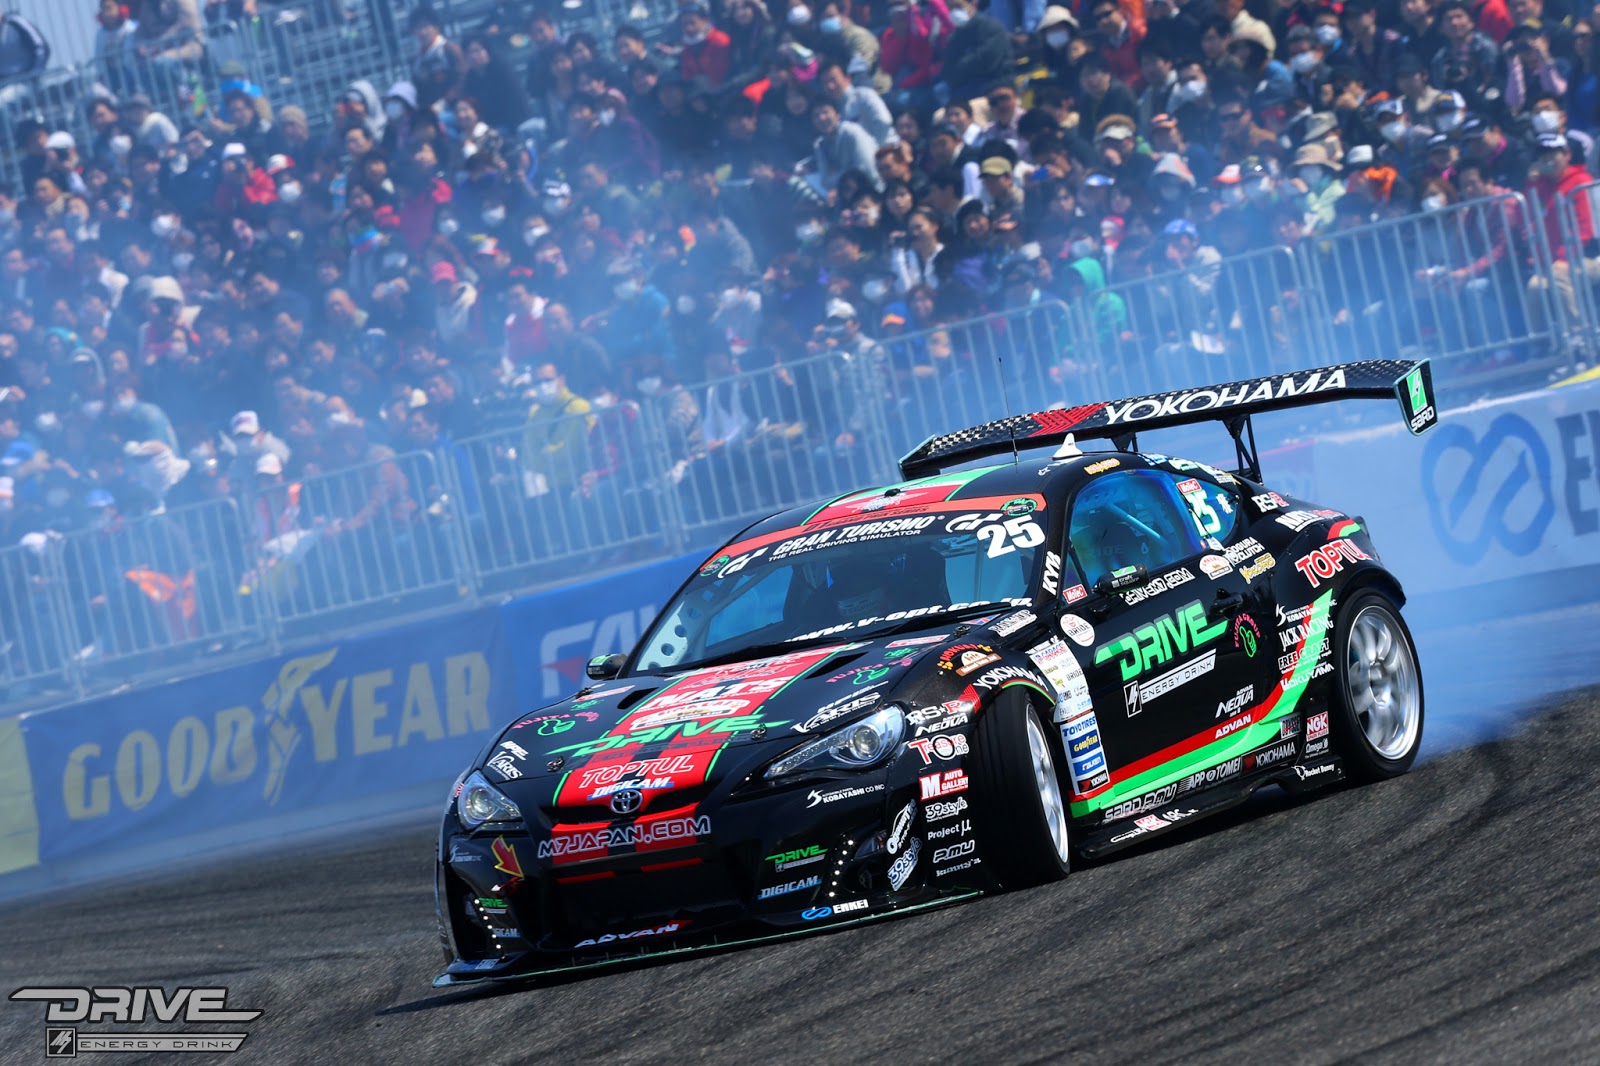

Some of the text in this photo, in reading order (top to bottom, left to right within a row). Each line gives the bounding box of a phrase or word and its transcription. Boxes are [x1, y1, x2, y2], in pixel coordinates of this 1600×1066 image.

[1106, 370, 1346, 425] YOKOHAMA
[768, 530, 921, 562] THE REAL DRIVING SIMULATOR
[774, 530, 837, 556] GRAN
[977, 515, 1046, 559] 25
[1067, 622, 1090, 638] BRIDE
[1094, 599, 1228, 682] DRIVE
[973, 665, 1049, 693] YOKOHAMA
[1141, 660, 1213, 701] ENERGY DRINK
[546, 713, 791, 758] DRIVE
[1215, 714, 1252, 739] ADVAN
[1307, 714, 1329, 736] NGK
[579, 754, 694, 789] TOPTUL
[1216, 757, 1241, 780] TOMEI
[1256, 752, 1296, 768] YOKOHAMA
[591, 776, 671, 799] DIGICAM
[921, 774, 942, 800] M
[944, 769, 963, 781] AUTO
[823, 784, 885, 803] KOBAYASHI CO INC
[925, 797, 968, 818] 39style
[537, 815, 711, 858] M7JAPAN.COM
[928, 824, 960, 841] Project
[765, 845, 828, 865] DRIVE
[760, 876, 819, 899] DIGICAM
[833, 899, 870, 914] ENKEI
[574, 923, 680, 949] ADVAN
